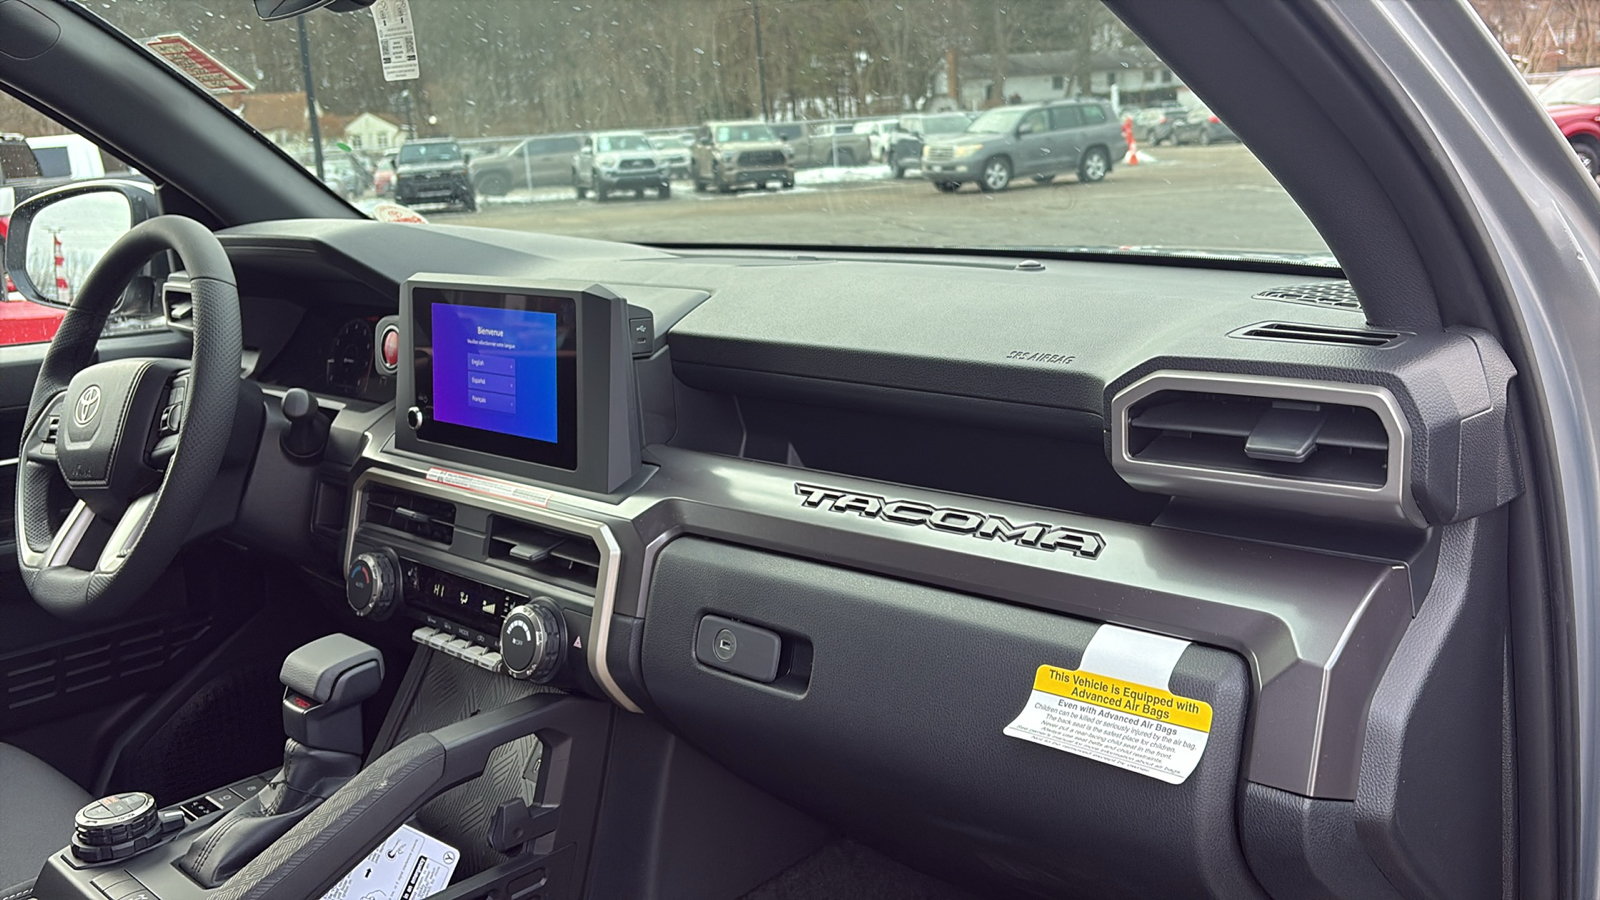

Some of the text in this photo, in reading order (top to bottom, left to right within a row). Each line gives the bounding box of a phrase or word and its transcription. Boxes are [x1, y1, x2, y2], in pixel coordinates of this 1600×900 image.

[1006, 350, 1076, 364] SRS AIRBAG
[794, 482, 1107, 560] TACOMA
[433, 583, 445, 598] HI
[1050, 669, 1200, 714] This Vehicle is Equipped with
[1071, 687, 1170, 720] Advanced Air Bags
[1034, 702, 1058, 714] Children
[1079, 714, 1096, 724] killed
[1102, 721, 1130, 734] seriously
[1130, 727, 1152, 738] injured
[1152, 733, 1161, 742] by
[1162, 736, 1172, 744] the
[1173, 738, 1182, 746] air
[1182, 740, 1196, 750] bag.
[1041, 720, 1058, 728] Never
[1107, 738, 1122, 746] child
[1057, 716, 1072, 725] back
[1072, 721, 1086, 729] seat
[1103, 730, 1122, 738] safest
[1122, 734, 1140, 744] place
[1140, 738, 1150, 746] for
[1058, 699, 1178, 736] Even with Advanced Air Bags
